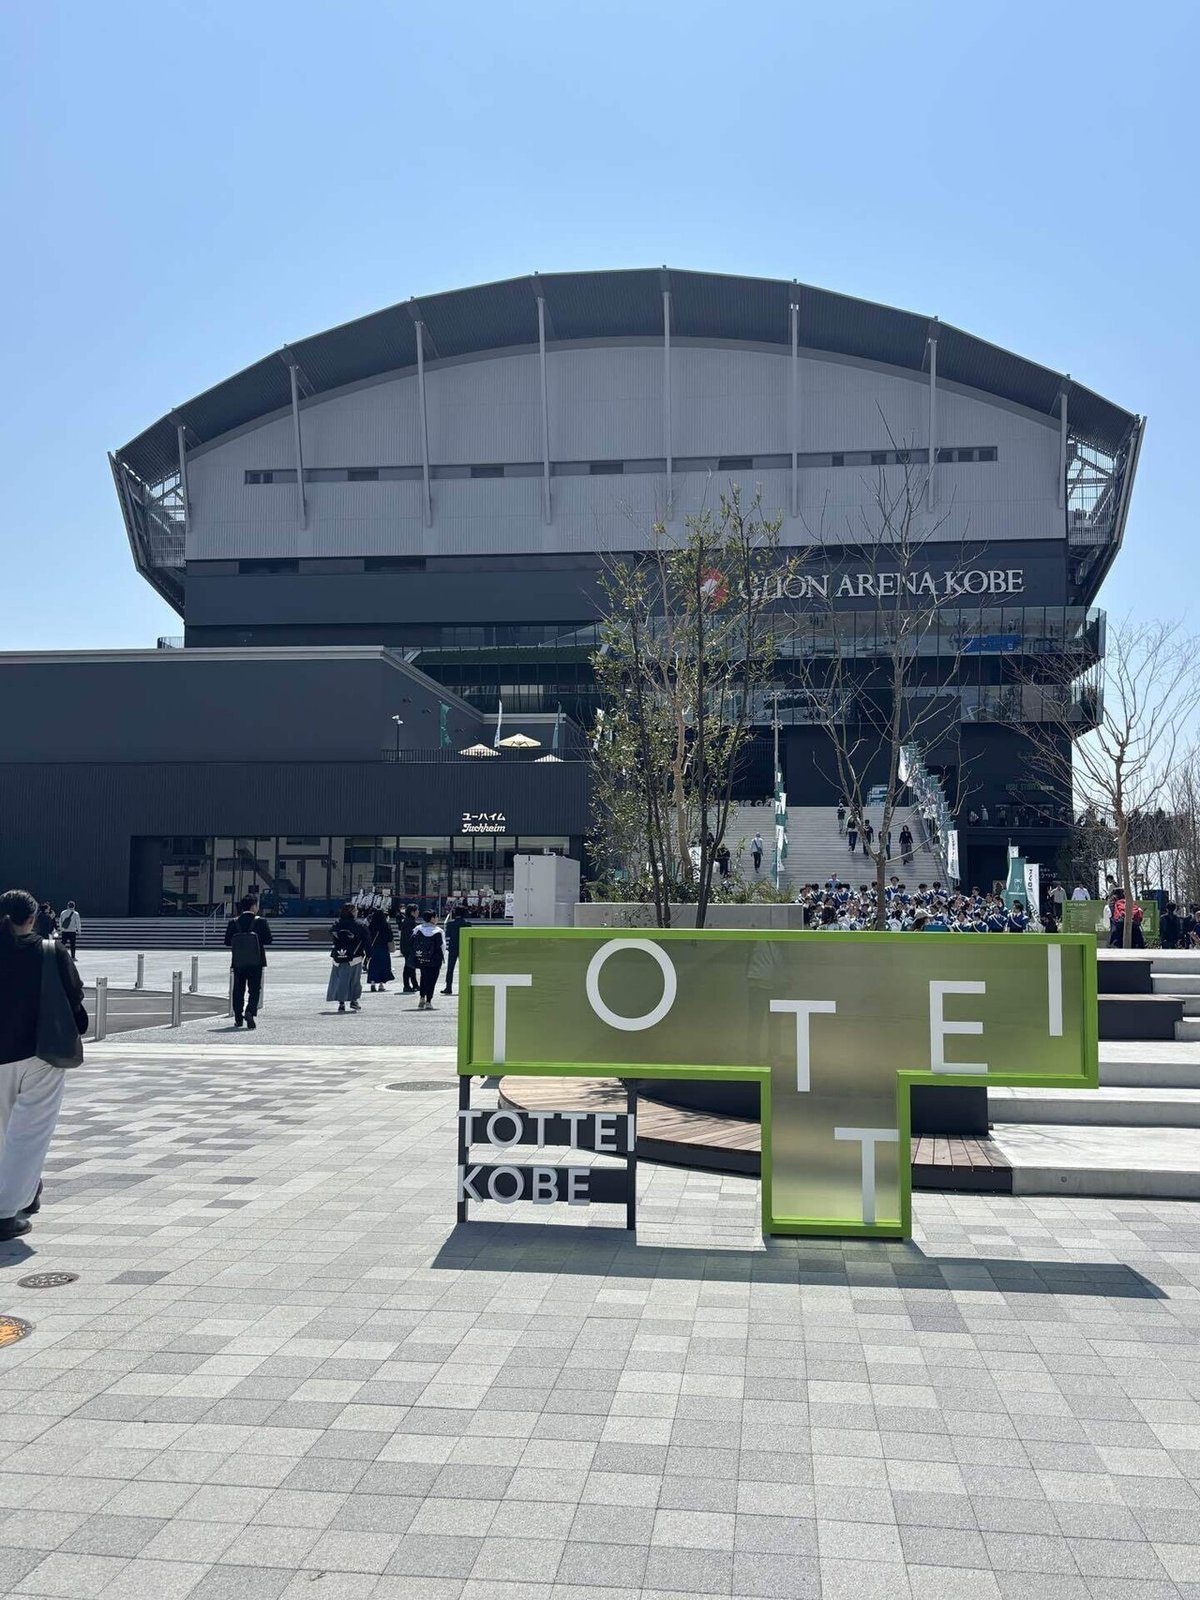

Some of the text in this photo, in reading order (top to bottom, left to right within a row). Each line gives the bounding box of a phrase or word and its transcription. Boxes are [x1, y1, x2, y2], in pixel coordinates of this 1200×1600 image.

[835, 571, 937, 598] ARENA
[944, 569, 1025, 594] KOBE
[461, 812, 506, 821] ユーハイム
[457, 1110, 635, 1151] TOTTEI
[457, 1165, 591, 1206] KOBE
